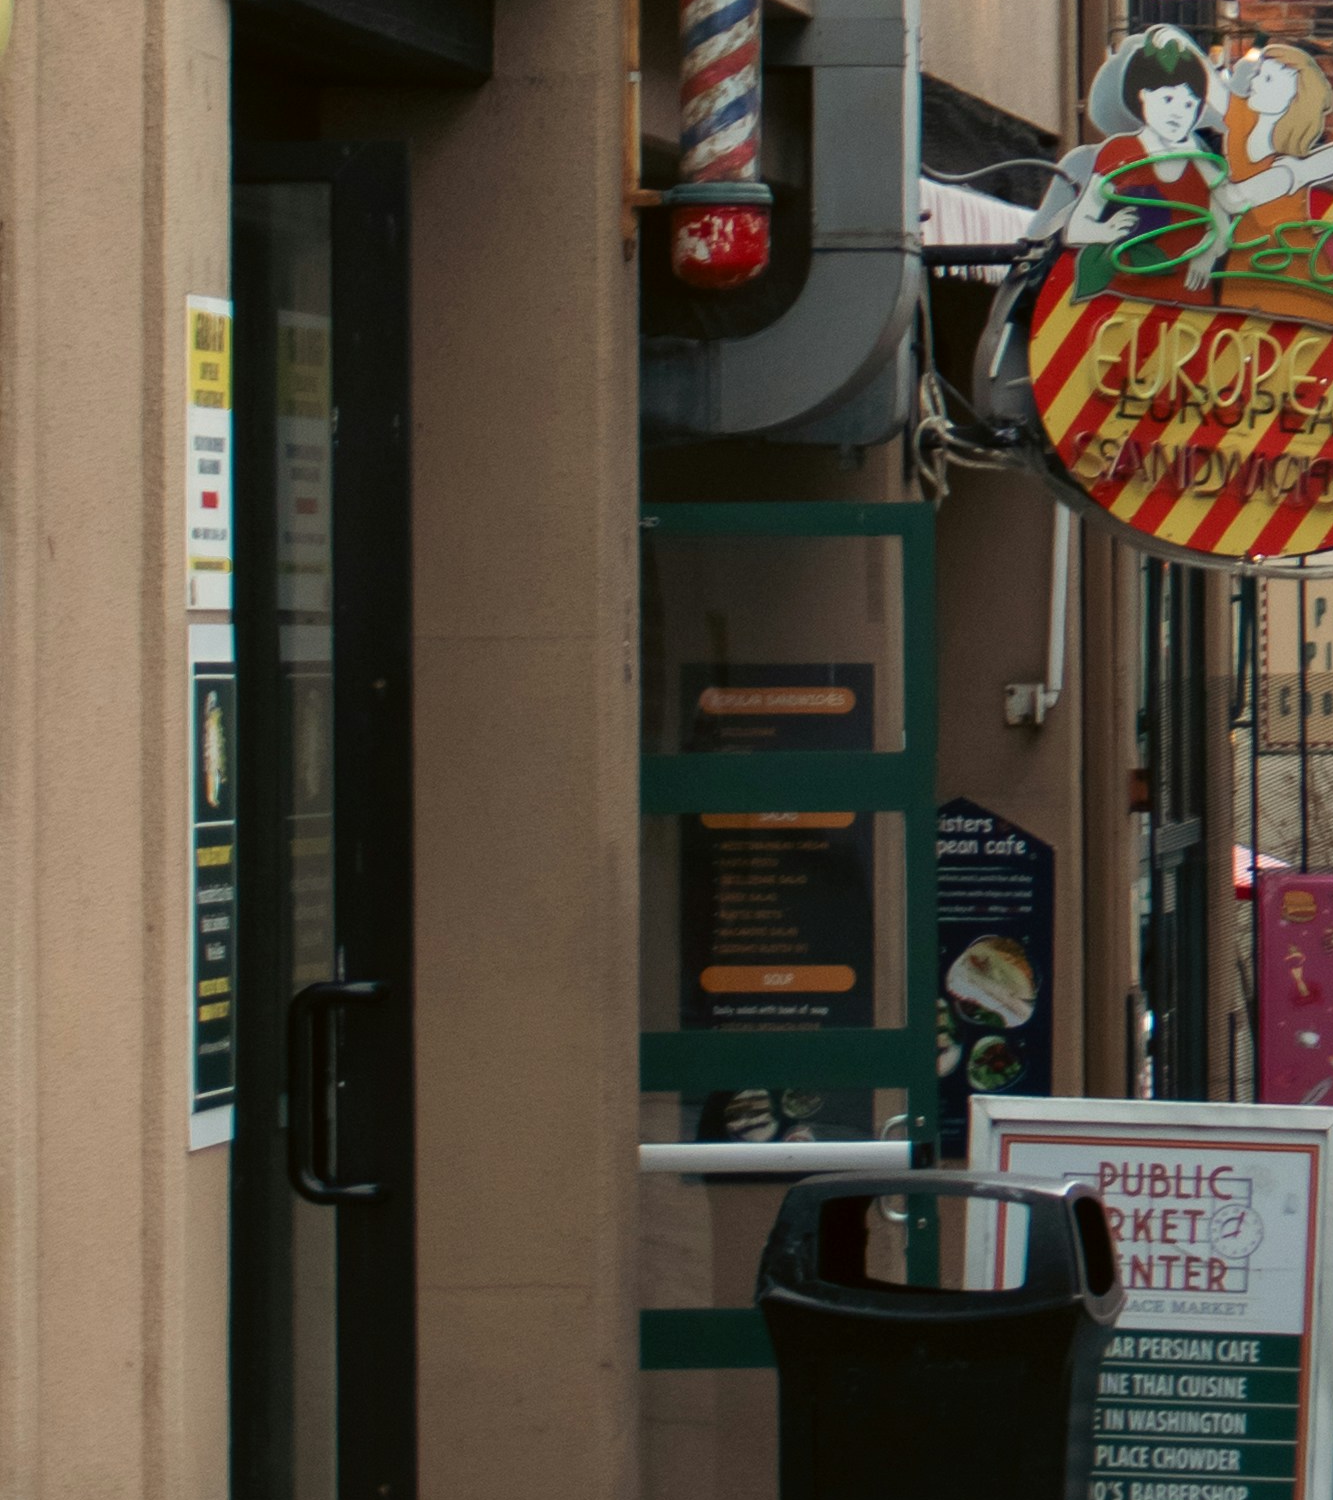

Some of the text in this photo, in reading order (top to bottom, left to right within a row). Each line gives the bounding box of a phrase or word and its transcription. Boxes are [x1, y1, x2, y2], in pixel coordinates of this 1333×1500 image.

[939, 813, 994, 833] isters
[936, 834, 1027, 859] pean cafe
[1098, 1161, 1233, 1201] PUBLIC
[1103, 1206, 1206, 1245] RKET
[1119, 1254, 1229, 1292] NTER
[1170, 1300, 1249, 1316] MARKET
[1138, 1337, 1213, 1362] PERSIAN
[1216, 1340, 1261, 1364] CAFE
[1100, 1372, 1248, 1400] INE THAI CUISINE
[1104, 1408, 1124, 1431] IN
[1127, 1409, 1248, 1435] WASHINGTON
[1094, 1444, 1241, 1472] PLACE CHOWDER
